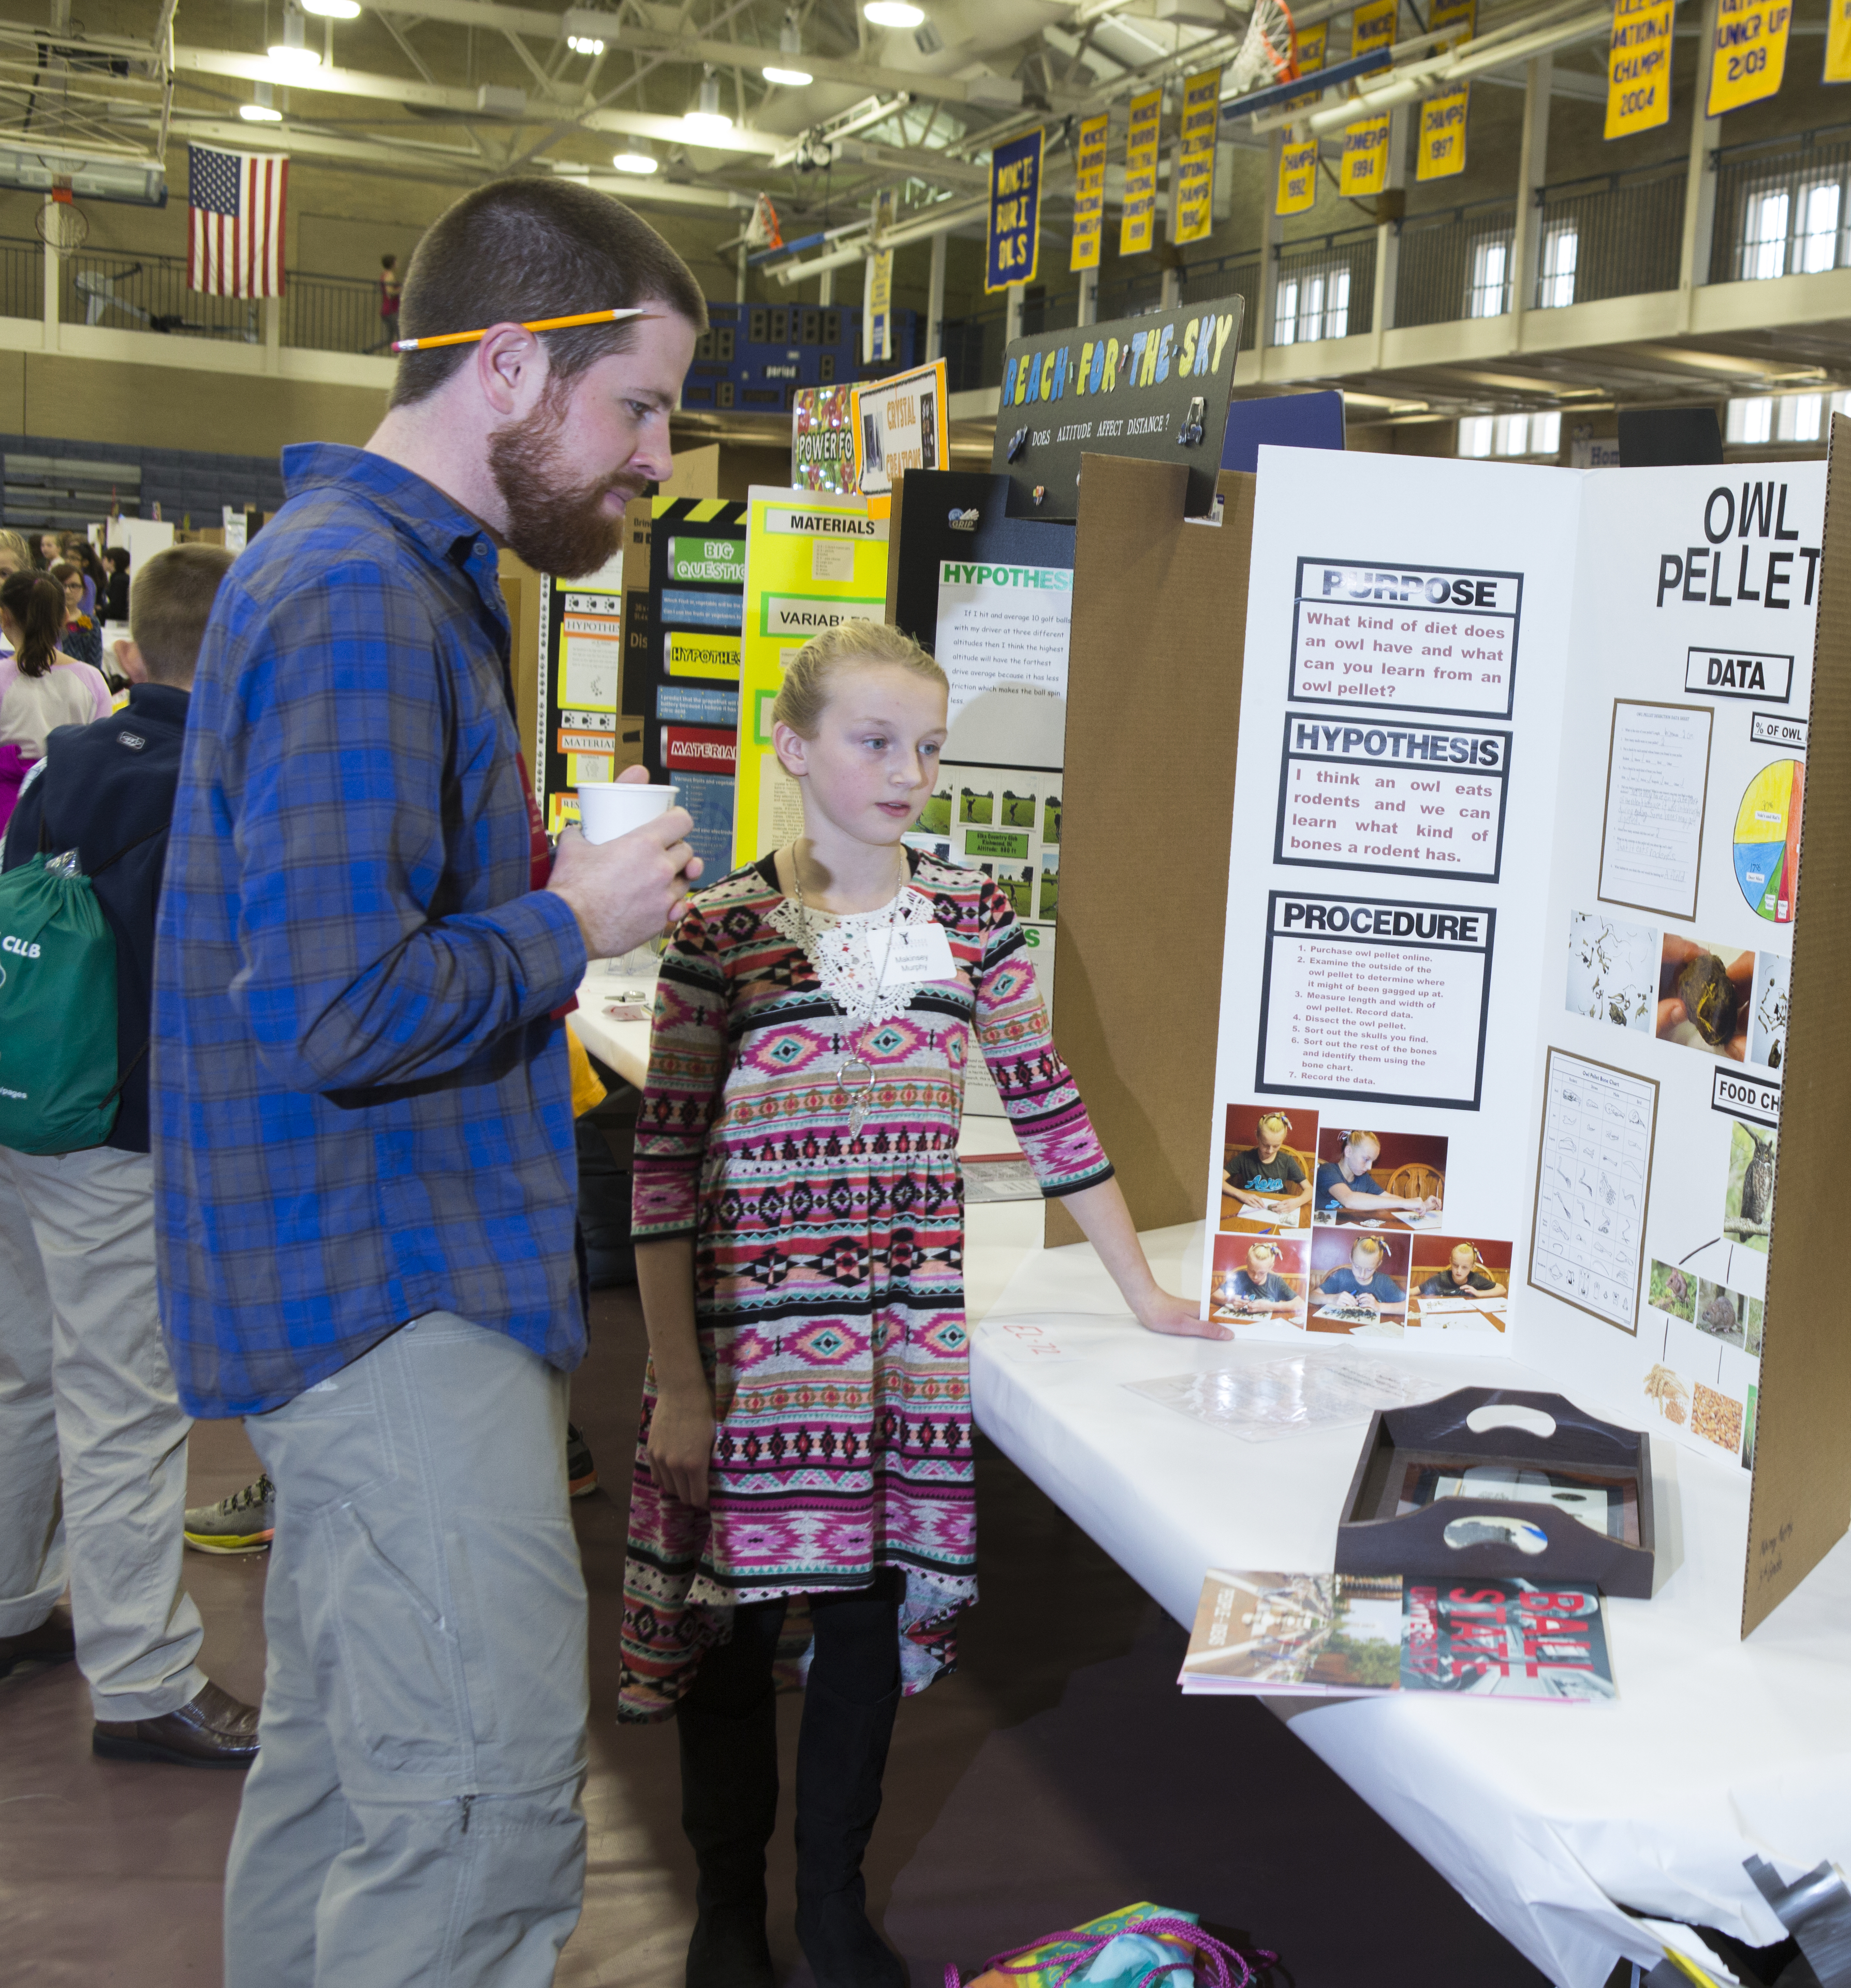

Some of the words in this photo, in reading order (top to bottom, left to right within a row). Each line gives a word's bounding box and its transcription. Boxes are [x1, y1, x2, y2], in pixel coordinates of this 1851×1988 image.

[1620, 86, 1655, 117] 2004
[766, 365, 796, 378] period
[1004, 346, 1068, 407] REACH
[1077, 338, 1119, 396] FOR
[1129, 324, 1174, 388] THE
[1179, 314, 1233, 378] SKY
[887, 394, 916, 430] CRYSTAL
[1032, 431, 1050, 446] DOES
[1056, 422, 1091, 442] ALTITUDE
[1096, 420, 1123, 437] AFFECT
[798, 432, 836, 462] POWER
[790, 515, 875, 535] MATERIALS
[1705, 481, 1799, 544] OWL
[704, 542, 734, 559] BIG
[1322, 569, 1498, 609] PURPOSE
[1656, 545, 1820, 609] PELLET
[780, 611, 870, 627] VARIAB
[981, 625, 1002, 634] driver
[1033, 630, 1064, 638] different
[1307, 611, 1350, 627] What
[1357, 616, 1393, 631] kind
[1400, 620, 1418, 632] of
[1424, 621, 1458, 635] diet
[1464, 624, 1505, 639] does
[953, 638, 983, 647] altitudes
[1039, 645, 1064, 653] highest
[1305, 637, 1326, 648] an
[1334, 638, 1364, 651] owl
[1373, 639, 1413, 654] have
[1421, 645, 1452, 657] and
[1461, 647, 1504, 662] what
[1304, 660, 1334, 670] can
[1343, 662, 1373, 675] you
[1382, 662, 1425, 678] learn
[1433, 666, 1473, 681] from
[1481, 673, 1502, 684] an
[1707, 657, 1766, 691] DATA
[1302, 680, 1332, 693] owl
[1338, 683, 1396, 697] pellet?
[1756, 721, 1764, 735] %
[1767, 724, 1780, 737] OF
[1782, 726, 1802, 741] OWL
[1295, 722, 1500, 767] HYPOTHESIS
[1296, 768, 1301, 781] I
[1316, 770, 1360, 786] think
[1375, 778, 1395, 789] an
[1410, 780, 1441, 793] owl
[1455, 784, 1492, 797] eats
[1294, 793, 1360, 808] rodents
[1374, 800, 1406, 812] and
[1420, 805, 1445, 815] we
[1459, 808, 1490, 820] can
[1292, 813, 1336, 829] learn
[1355, 820, 1398, 835] what
[1416, 824, 1453, 839] kind
[1471, 829, 1489, 842] of
[1290, 836, 1342, 852] bones
[1347, 843, 1358, 853] a
[1363, 844, 1420, 859] rodent
[1426, 847, 1461, 863] has.
[1283, 902, 1479, 942] PROCEDURE
[1310, 957, 1348, 967] Examine
[1369, 963, 1402, 971] outside
[1311, 945, 1353, 955] Purchase
[1402, 954, 1433, 962] online.
[901, 964, 928, 973] Murphy
[1327, 971, 1353, 979] pellet
[1368, 974, 1414, 984] determine
[1417, 978, 1445, 986] where
[1317, 982, 1343, 990] might
[1357, 984, 1379, 992] been
[1382, 988, 1415, 996] gagged
[1590, 1073, 1600, 1081] Pellet
[1600, 1076, 1609, 1084] Bone
[1609, 1079, 1620, 1087] Chart
[1720, 1080, 1756, 1105] FOOD
[1449, 1586, 1510, 1678] STATE
[1519, 1590, 1594, 1679] BALL
